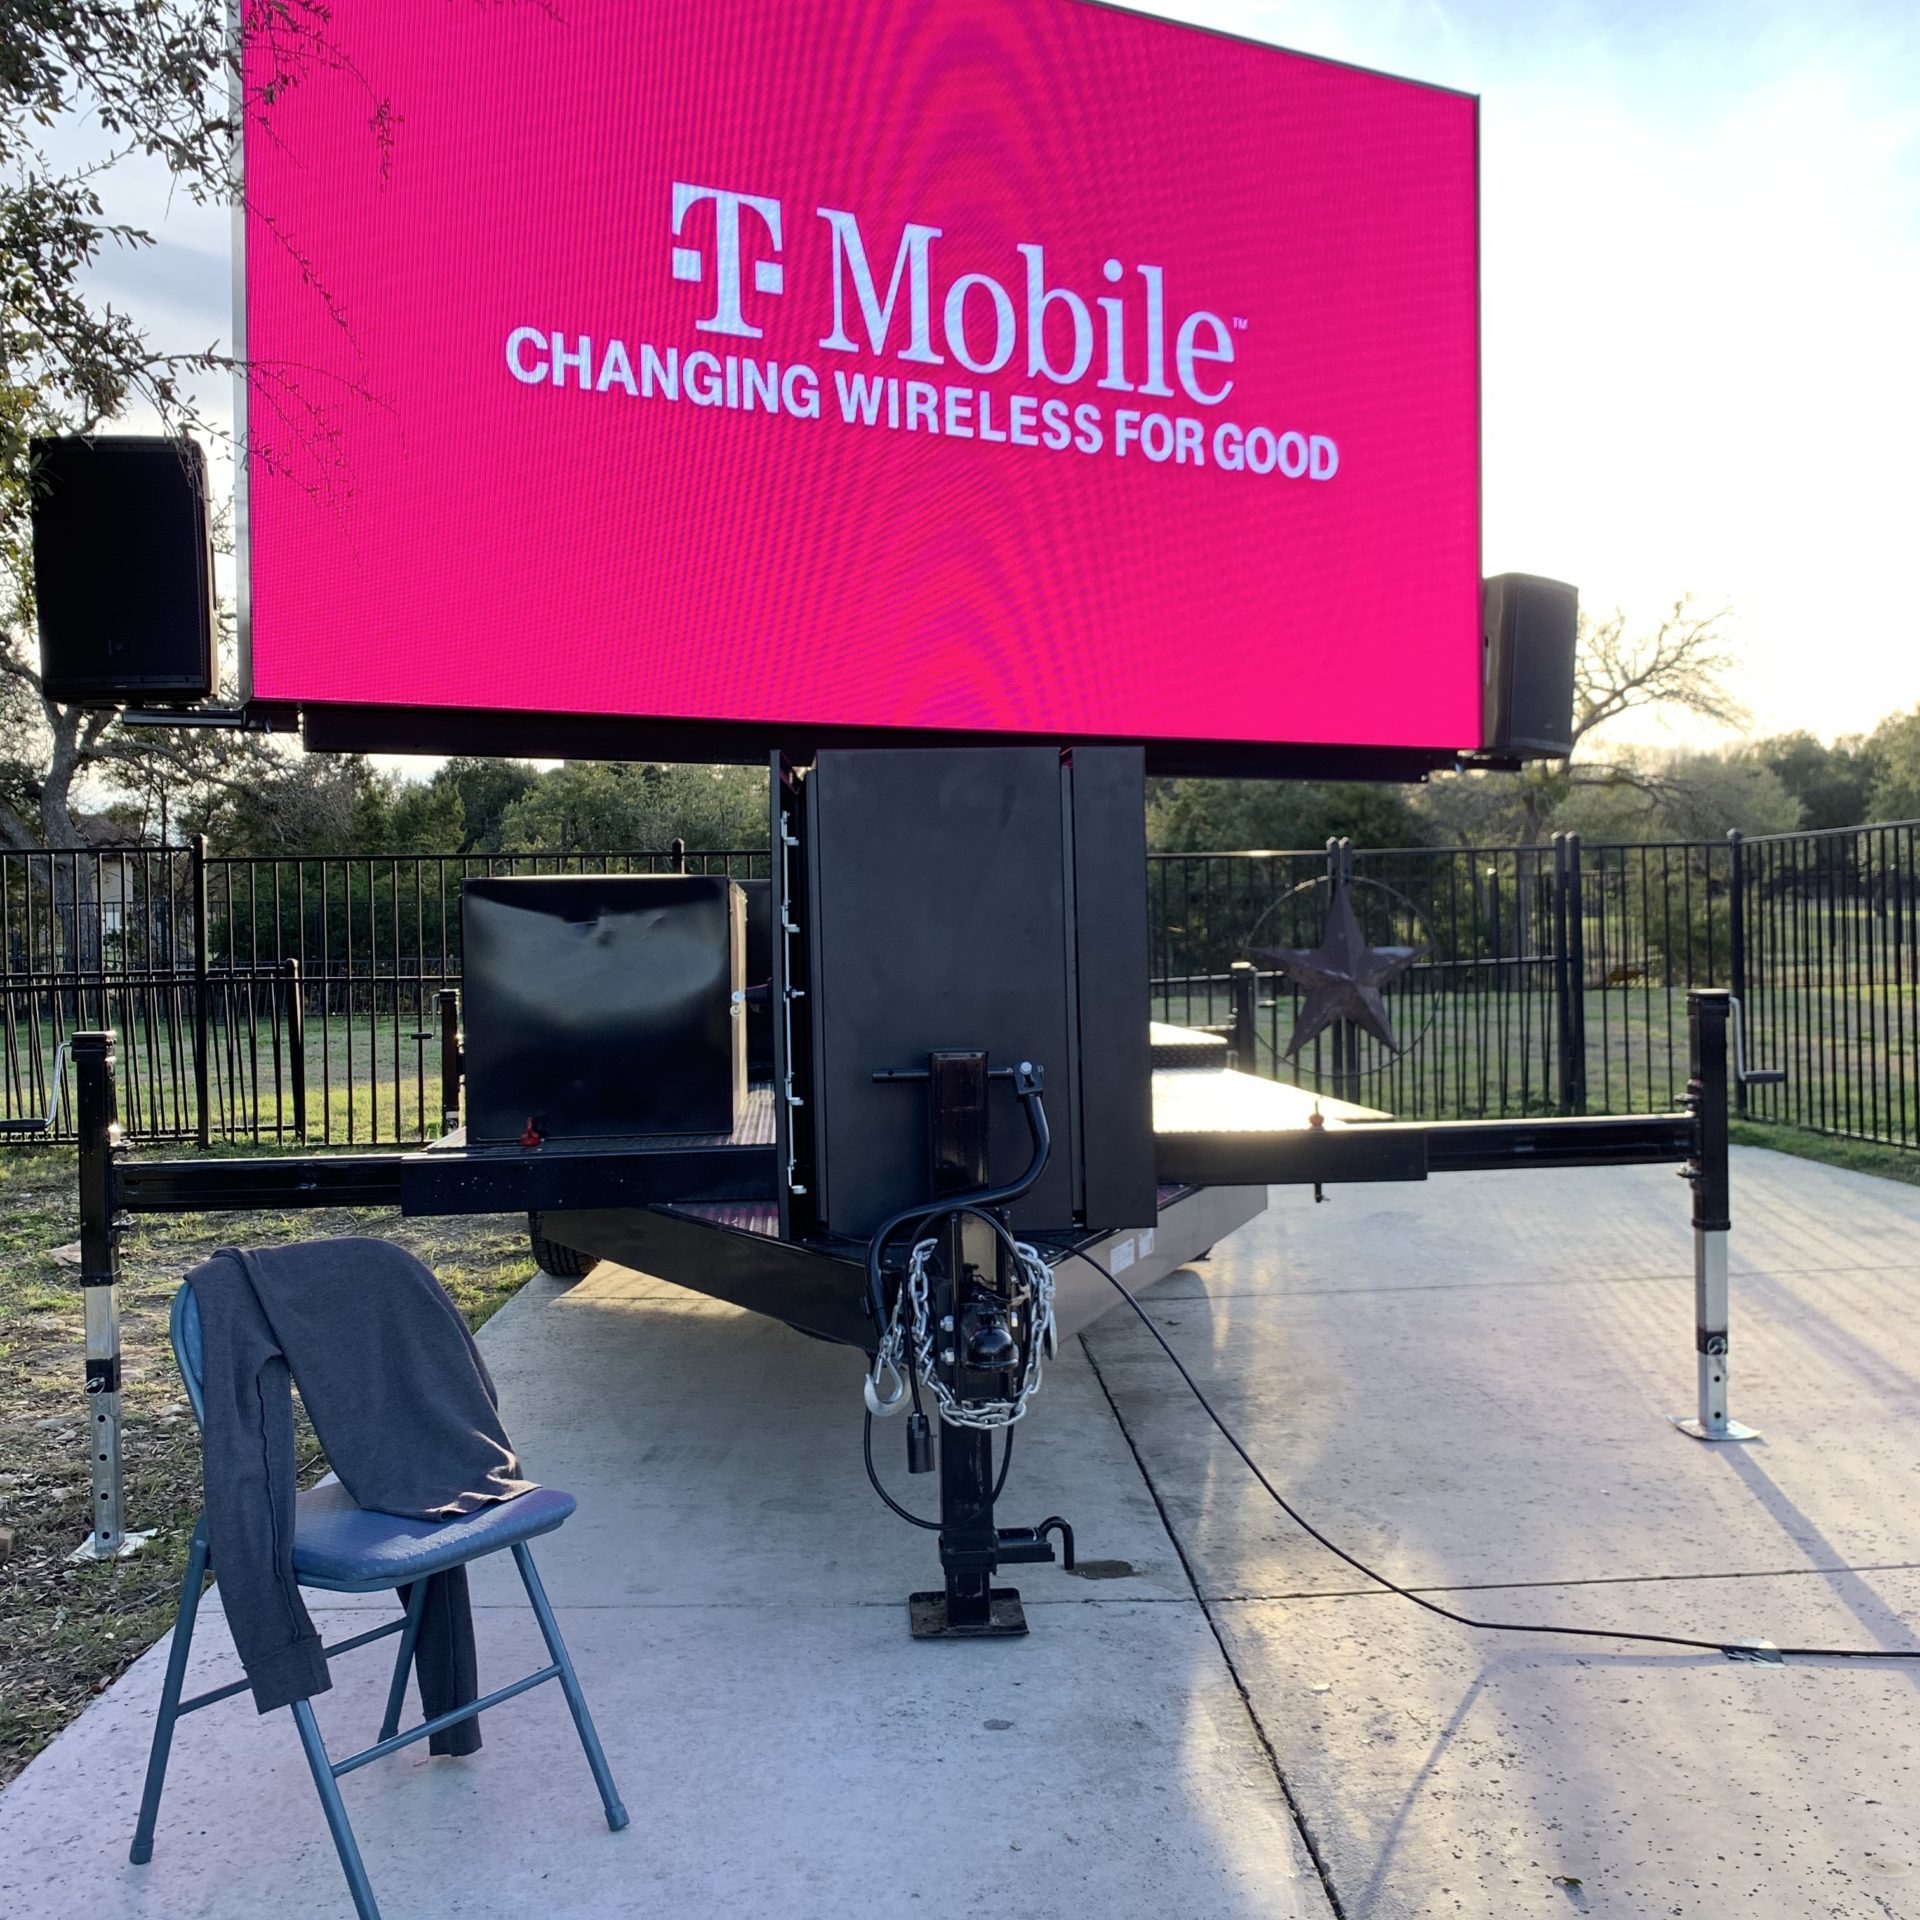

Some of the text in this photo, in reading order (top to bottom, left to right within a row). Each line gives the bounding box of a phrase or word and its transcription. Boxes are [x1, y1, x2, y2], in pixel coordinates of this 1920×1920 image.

[816, 207, 1236, 406] Mobile
[505, 326, 1339, 481] CHANGING WIRELESS FOR GOOD
